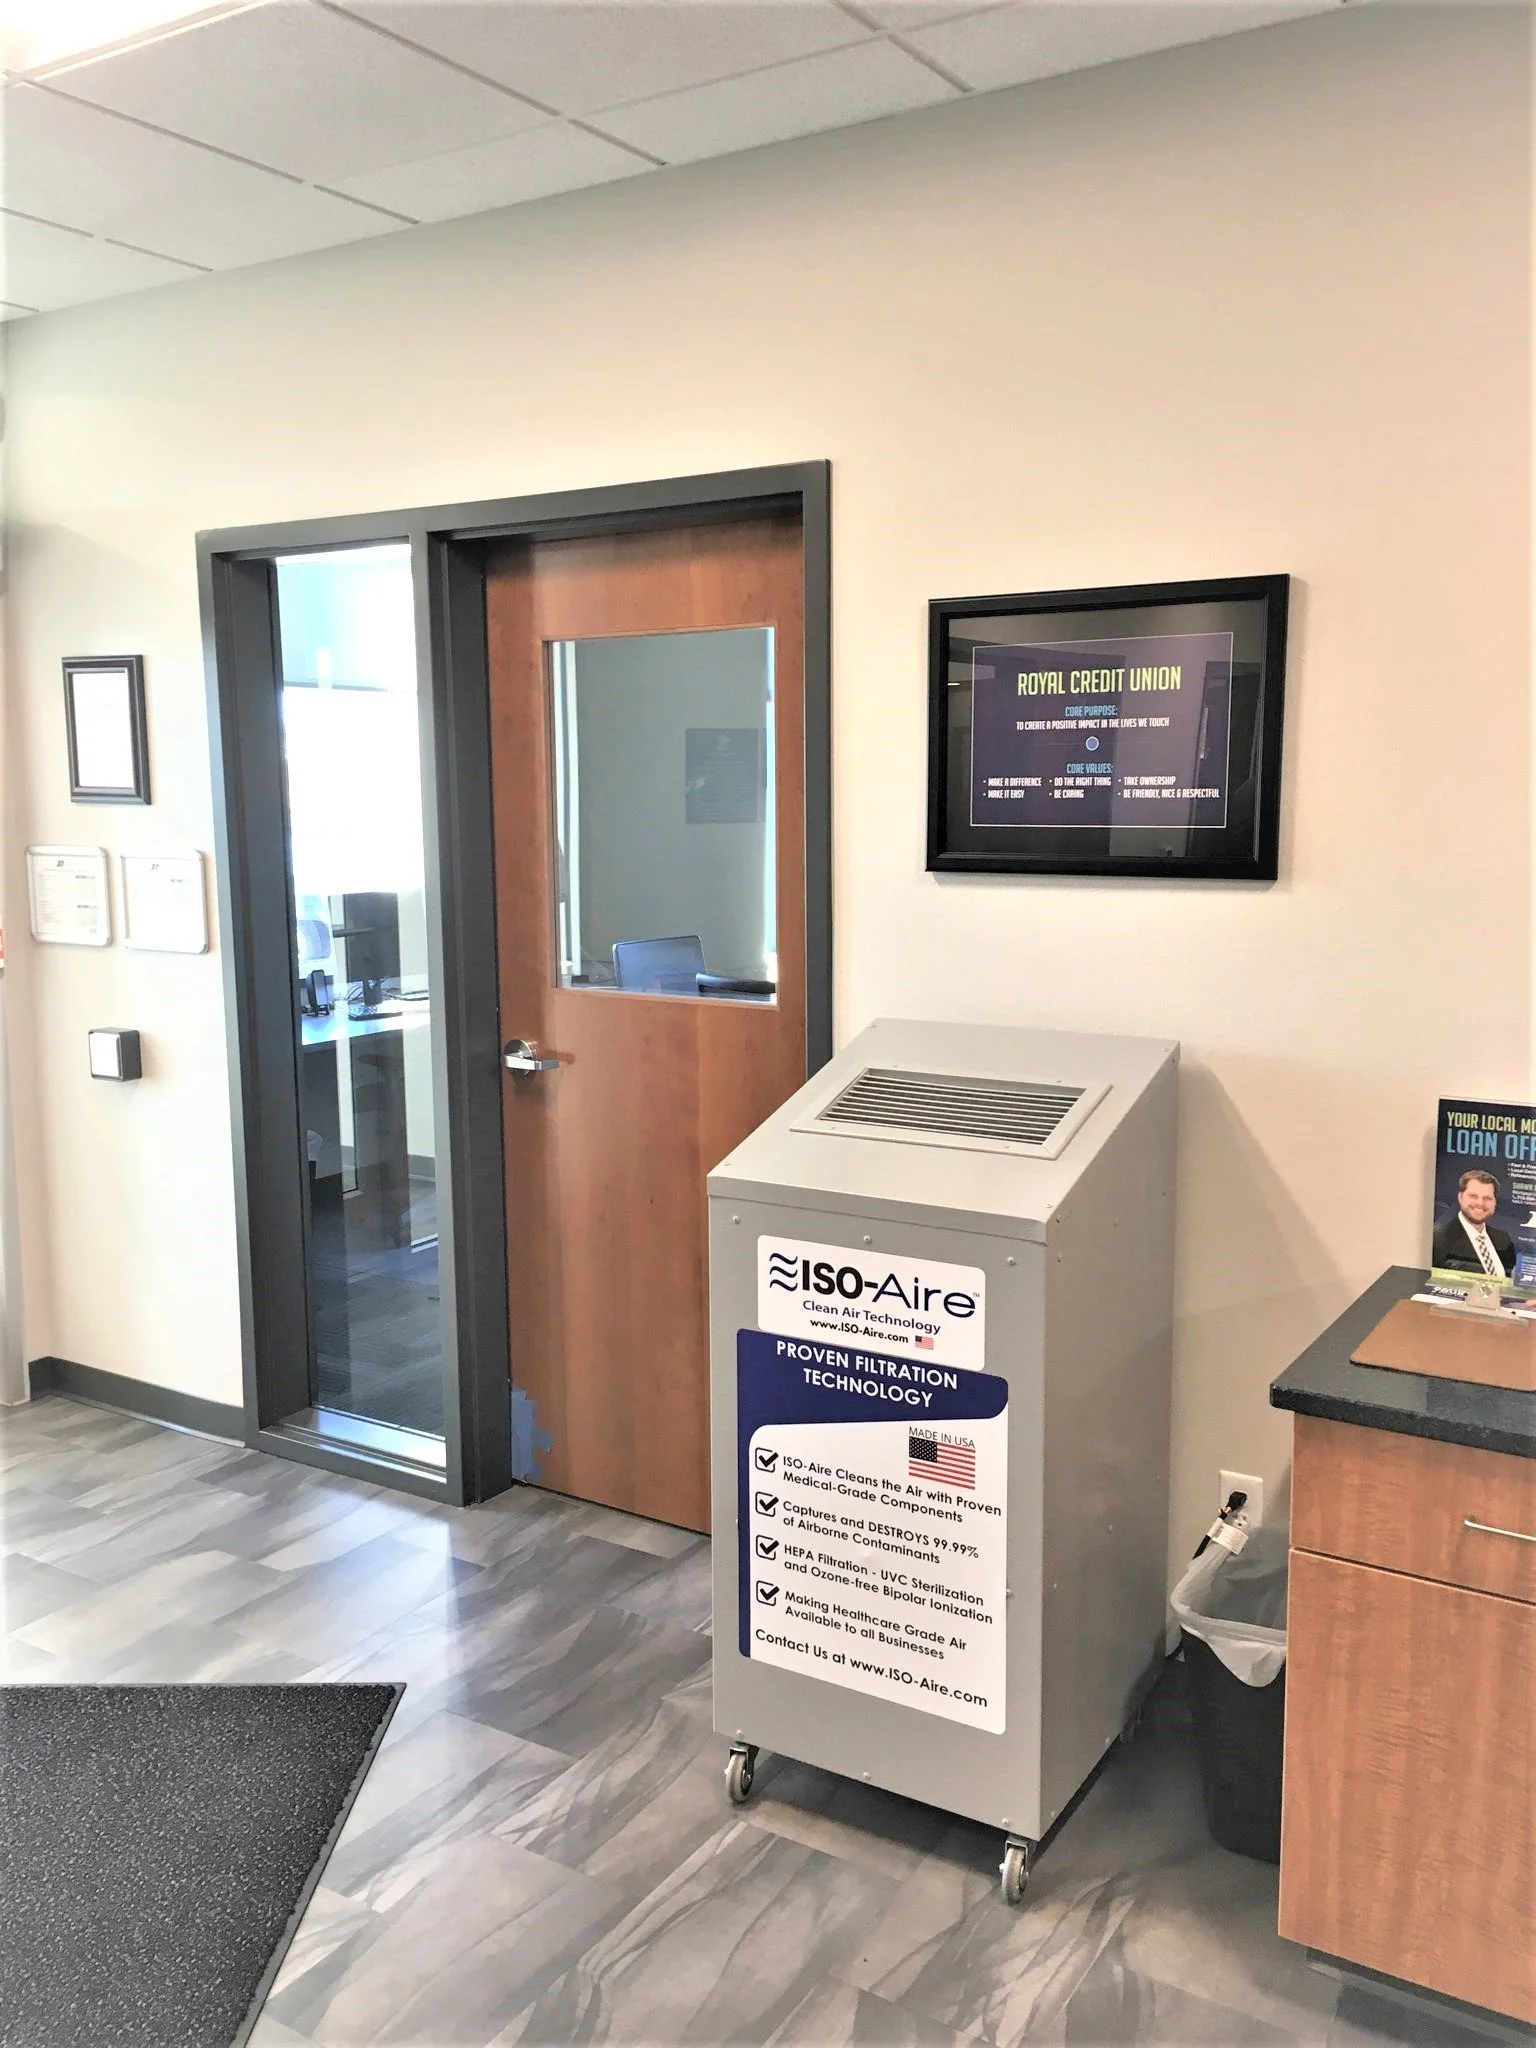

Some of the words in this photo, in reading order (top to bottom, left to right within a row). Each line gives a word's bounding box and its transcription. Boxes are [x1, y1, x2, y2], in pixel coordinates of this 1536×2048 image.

[1017, 672, 1065, 696] ROYAL
[1070, 669, 1125, 694] CREDIT
[1130, 666, 1181, 692] UNION
[1016, 722, 1024, 730] TO
[1025, 721, 1045, 730] CREATE
[1046, 721, 1051, 729] A
[1052, 720, 1077, 729] POSITIVE
[1078, 719, 1100, 729] IMPACT
[1101, 719, 1107, 728] IN
[1108, 719, 1120, 728] THE
[1121, 718, 1137, 727] LIVES
[1138, 718, 1148, 727] WE
[1149, 717, 1169, 727] TOUCH
[1065, 706, 1083, 717] CORE
[1084, 705, 1118, 716] PURPOSE:
[988, 778, 1003, 786] MAKE
[1004, 778, 1009, 786] A
[1010, 778, 1042, 786] DIFFERENCE
[1054, 777, 1063, 786] DO
[1064, 777, 1074, 786] THE
[1076, 777, 1092, 786] RIGHT
[1094, 777, 1111, 785] THING
[1067, 763, 1084, 773] CORE
[1086, 763, 1113, 773] VALUES:
[1124, 777, 1138, 785] TAKE
[1140, 776, 1176, 785] OWNERSHIP
[988, 790, 1003, 798] MAKE
[1004, 790, 1010, 798] IT
[1011, 790, 1025, 798] EASY
[1054, 790, 1062, 798] BE
[1063, 790, 1084, 798] CARING
[1124, 789, 1131, 798] BE
[1132, 789, 1160, 799] FRIENDLY,
[1161, 789, 1175, 798] NICE
[1177, 789, 1181, 798] &
[1182, 789, 1220, 798] RESPECTFUL
[1447, 1112, 1478, 1129] YOUR
[1482, 1115, 1517, 1132] LOCAL
[1447, 1128, 1498, 1157] LOAN
[802, 1260, 975, 1318] ISO-Aire
[803, 1300, 838, 1315] Clean
[842, 1308, 860, 1319] Air
[864, 1311, 941, 1335] Technology
[810, 1320, 909, 1344] www.ISO-Aire.com
[777, 1341, 849, 1368] PROVEN
[856, 1355, 957, 1389] FILTRATION
[803, 1368, 933, 1407] TECHNOLOGY
[909, 1426, 938, 1440] MADE
[941, 1433, 951, 1443] IN
[955, 1436, 975, 1448] USA
[783, 1456, 832, 1476] ISO-Aire
[836, 1469, 878, 1487] Cleans
[882, 1479, 902, 1492] the
[906, 1485, 923, 1497] Air
[926, 1491, 952, 1504] with
[957, 1496, 1001, 1516] Proven
[783, 1471, 876, 1501] Medical-Grade
[881, 1494, 963, 1522] Components
[783, 1501, 837, 1522] Captures
[841, 1517, 864, 1529] and
[869, 1522, 929, 1545] DESTROYS
[934, 1537, 979, 1558] 99.99%
[783, 1517, 794, 1526] of
[798, 1519, 848, 1540] Airborne
[853, 1533, 940, 1563] Contaminants
[785, 1545, 814, 1560] HEPA
[818, 1553, 868, 1575] Filtration
[881, 1570, 908, 1586] UVC
[912, 1578, 984, 1605] Sterilization
[784, 1561, 807, 1573] and
[811, 1566, 879, 1593] Ozone-free
[883, 1586, 926, 1605] Bipolar
[930, 1598, 993, 1624] Ionization
[785, 1591, 829, 1613] Making
[833, 1604, 900, 1631] Healthcare
[905, 1625, 945, 1644] Grade
[950, 1637, 967, 1650] Air
[785, 1606, 841, 1629] Available
[845, 1622, 857, 1634] to
[860, 1629, 874, 1639] all
[879, 1632, 944, 1659] Businesses
[756, 1629, 809, 1654] Contact
[813, 1645, 828, 1659] Us
[832, 1653, 846, 1664] at
[850, 1658, 988, 1707] www.ISO-Aire.com
